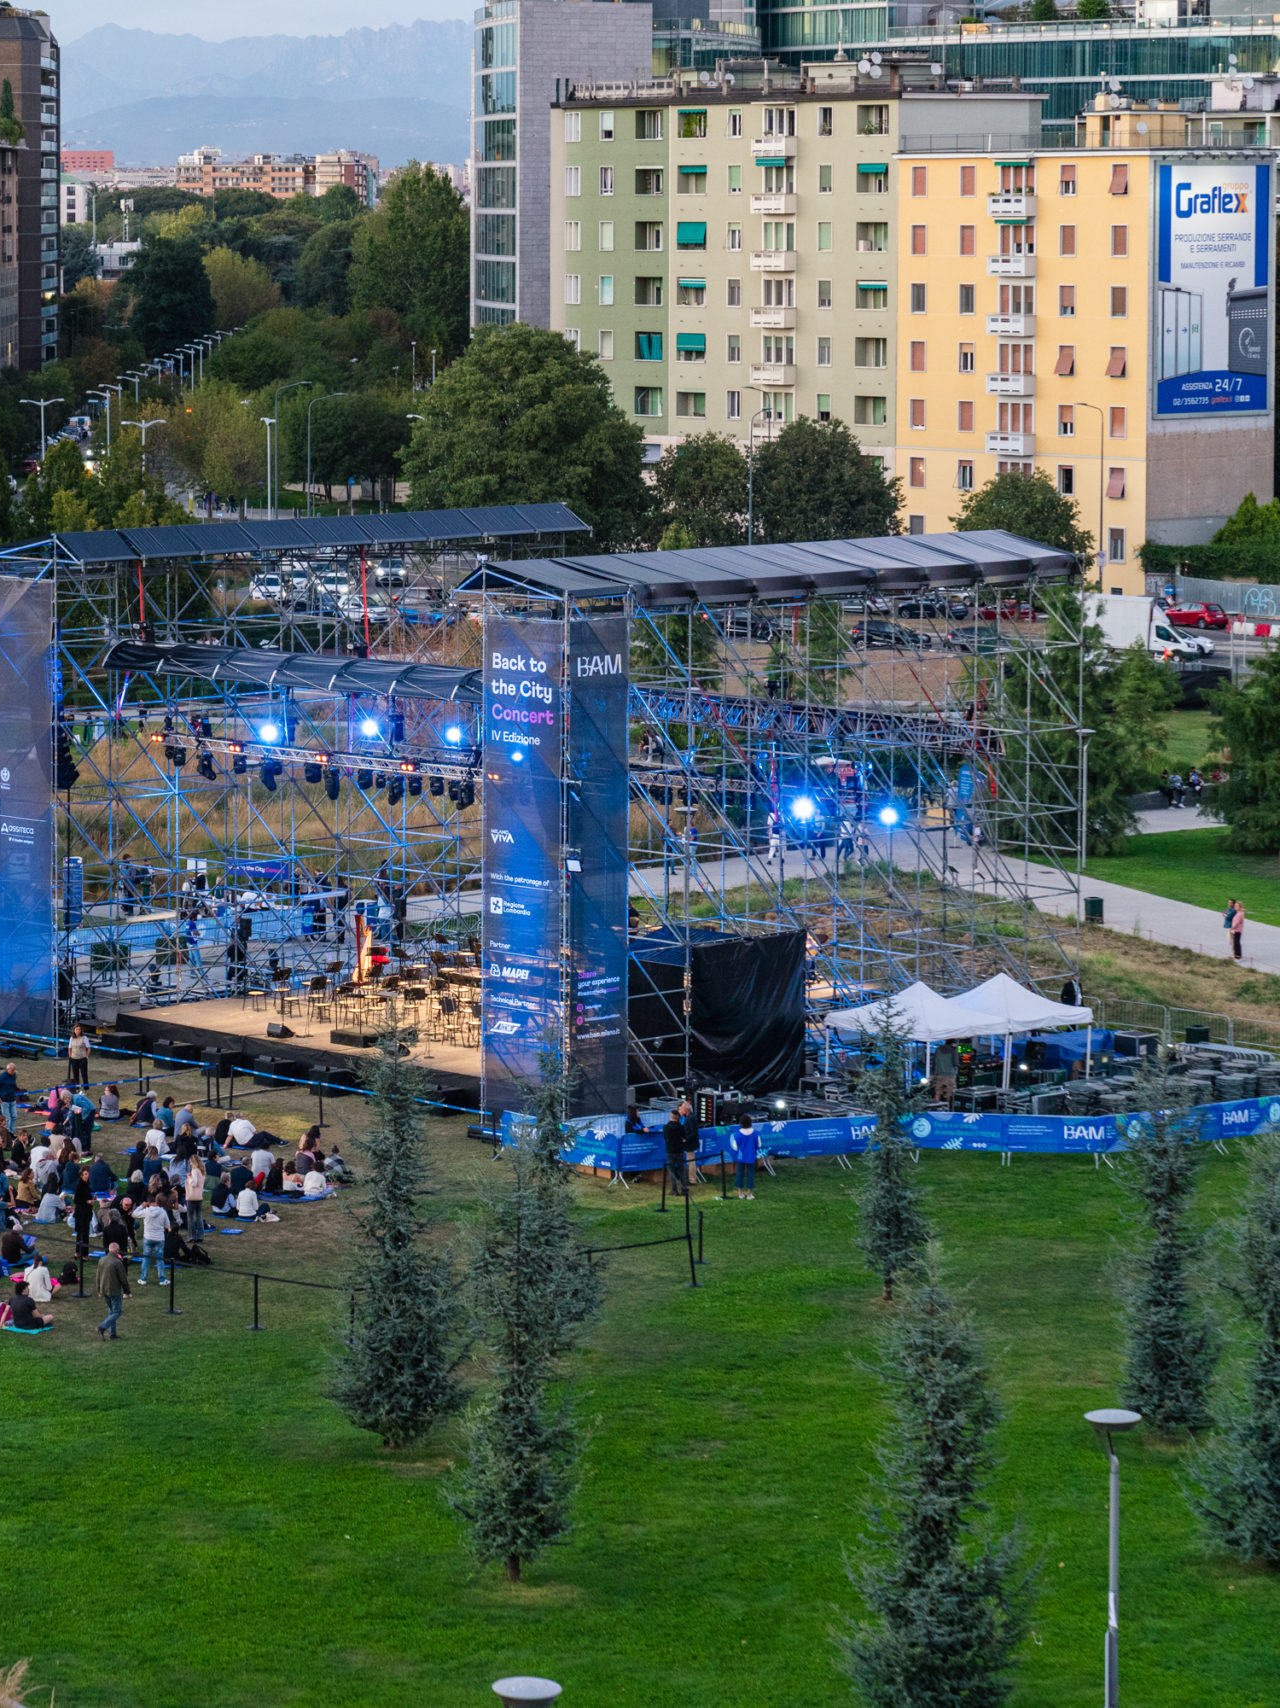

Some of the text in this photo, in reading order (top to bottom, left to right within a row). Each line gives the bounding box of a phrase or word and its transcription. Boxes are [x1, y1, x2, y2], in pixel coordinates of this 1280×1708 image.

[1222, 182, 1249, 192] gruppo
[1174, 232, 1252, 243] PRODUZIONE SERRANDE
[1189, 243, 1237, 253] E SERRAMENTI
[1180, 261, 1219, 270] MANUTENZIONE
[1181, 377, 1243, 392] ASSISTENZA 24/7
[492, 652, 547, 674] Back to
[577, 654, 622, 678] BAM
[491, 679, 553, 704] the City
[491, 704, 554, 726] Concert
[491, 730, 541, 746] IV Edizione
[255, 865, 266, 874] City
[490, 872, 550, 888] With the patronage of
[503, 901, 525, 910] Regione
[503, 907, 531, 917] Lombardia
[489, 940, 511, 950] Partner
[502, 967, 530, 980] MAPEI
[578, 971, 597, 980] Share
[577, 976, 621, 990] your experience
[490, 995, 536, 1009] Technical Partner
[1222, 1109, 1249, 1126] BAM
[1063, 1125, 1105, 1140] BAM
